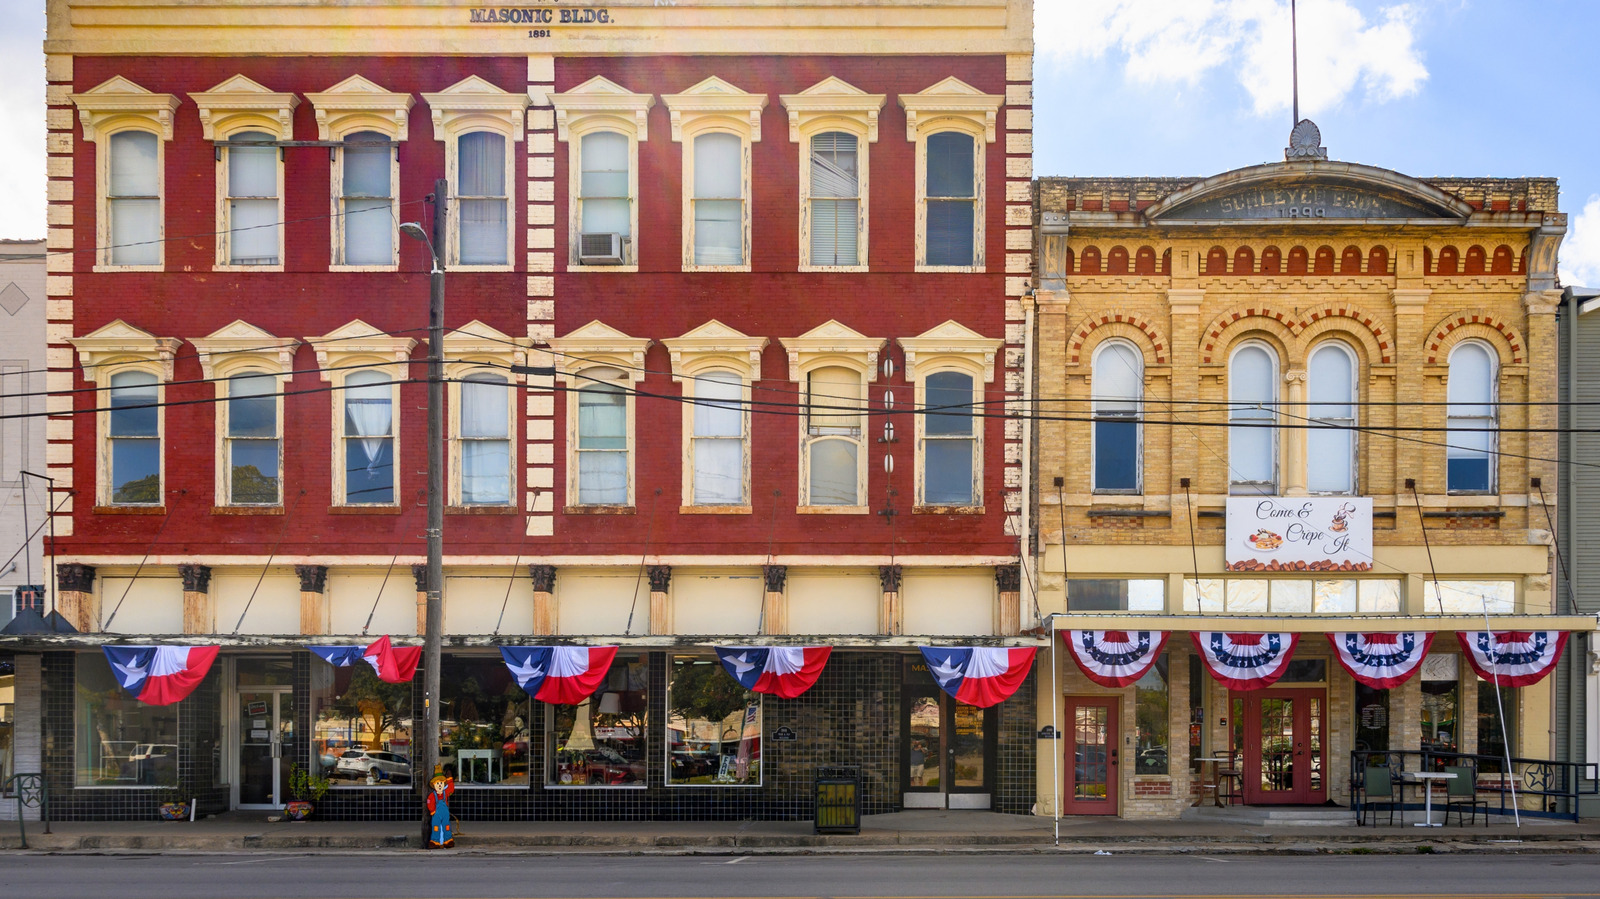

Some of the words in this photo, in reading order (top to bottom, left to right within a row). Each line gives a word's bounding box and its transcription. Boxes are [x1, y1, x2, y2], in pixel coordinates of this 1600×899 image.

[470, 9, 553, 23] MASONIC
[560, 9, 615, 23] BLDG.
[528, 30, 551, 38] 1891
[1280, 207, 1326, 218] 1899
[1256, 500, 1294, 519] Come
[1297, 502, 1313, 518] &
[1323, 533, 1351, 555] It
